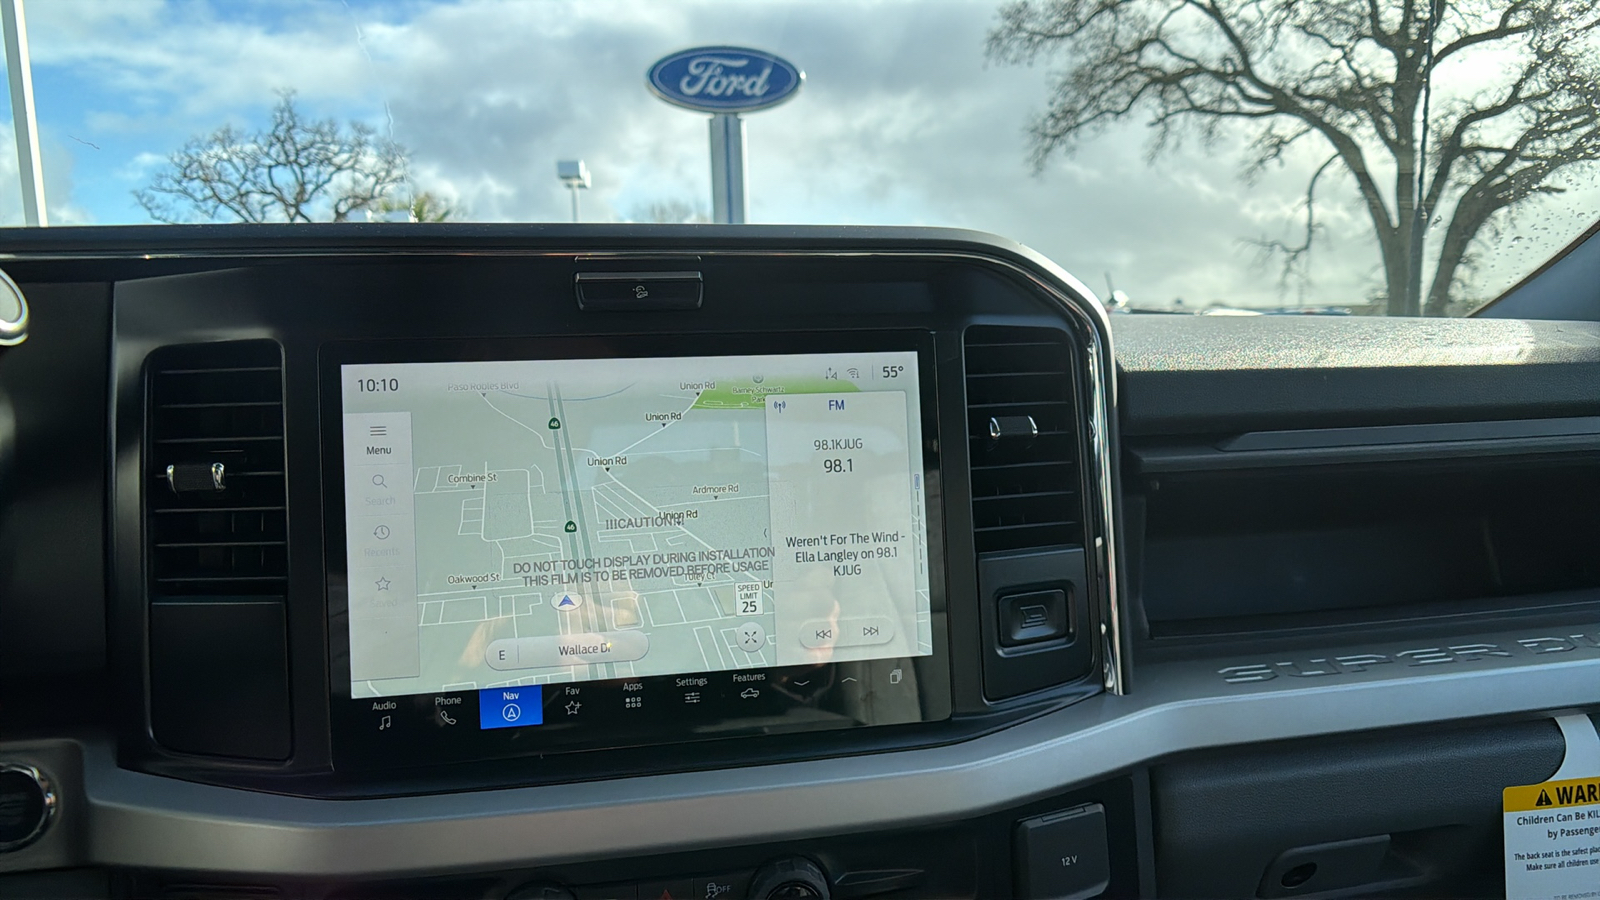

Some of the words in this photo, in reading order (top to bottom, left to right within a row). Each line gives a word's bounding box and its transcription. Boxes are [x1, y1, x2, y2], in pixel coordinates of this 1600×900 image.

[679, 56, 773, 96] Ford
[357, 378, 399, 392] 10:10
[447, 383, 469, 391] Paso
[470, 382, 499, 391] Robles
[500, 381, 519, 390] Blvd
[680, 382, 703, 390] Union
[704, 381, 715, 389] Rd
[828, 400, 845, 411] FM
[645, 413, 669, 421] Union
[670, 412, 682, 420] Rd
[550, 420, 559, 428] 46
[813, 439, 863, 451] 98.1KJUG
[366, 446, 392, 456] Menu
[587, 457, 612, 466] Union
[615, 456, 627, 465] Rd
[823, 458, 853, 473] 98.1
[447, 473, 486, 484] Combine
[487, 473, 497, 482] St
[693, 485, 726, 494] Ardmore
[728, 484, 739, 493] Rd
[365, 496, 396, 506] Search
[686, 510, 698, 518] Rd
[566, 523, 575, 531] 46
[785, 535, 828, 548] Weren't
[830, 534, 847, 546] For
[849, 533, 870, 544] The
[871, 531, 899, 543] Wind
[364, 547, 400, 557] Recents
[795, 551, 815, 563] Ella
[817, 549, 859, 563] Langley
[861, 550, 874, 559] on
[876, 547, 897, 559] 98.1
[513, 562, 531, 574] DO
[533, 561, 558, 573] NOT
[560, 558, 601, 570] TOUCH
[604, 554, 651, 568] DISPLAY
[653, 551, 696, 565] DURING
[699, 547, 775, 561] INSTALLATION
[522, 574, 549, 587] THIS
[551, 573, 578, 585] FILM
[581, 572, 592, 583] IS
[593, 570, 609, 582] TO
[612, 569, 627, 580] BE
[629, 566, 685, 580] REMOVED
[687, 562, 730, 575] BEFORE
[732, 560, 769, 572] USAGE
[833, 564, 862, 576] KJUG
[447, 575, 488, 585] Oakwood
[490, 574, 500, 583] St
[737, 584, 760, 592] SPEED
[740, 592, 758, 600] LIMIT
[742, 601, 757, 613] 25
[499, 650, 505, 660] E
[558, 644, 599, 656] Wallace
[1217, 643, 1513, 684] SUPER
[676, 676, 708, 687] Settings
[733, 673, 765, 682] Features
[565, 687, 580, 695] Fav
[623, 682, 643, 692] Apps
[435, 696, 462, 706] Phone
[503, 692, 519, 700] Nav
[372, 701, 397, 711] Audio
[1556, 783, 1600, 805] WAR
[1516, 815, 1554, 826] Children
[1556, 813, 1573, 822] Can
[1575, 811, 1585, 820] Be
[1547, 829, 1558, 840] by
[1514, 853, 1525, 861] The
[1526, 852, 1540, 860] back
[1561, 849, 1571, 857] the
[1572, 847, 1588, 856] safest
[1061, 856, 1071, 866] 12
[1072, 855, 1078, 864] V
[1526, 863, 1542, 871] Make
[1566, 858, 1589, 868] children
[716, 885, 731, 893] OFF
